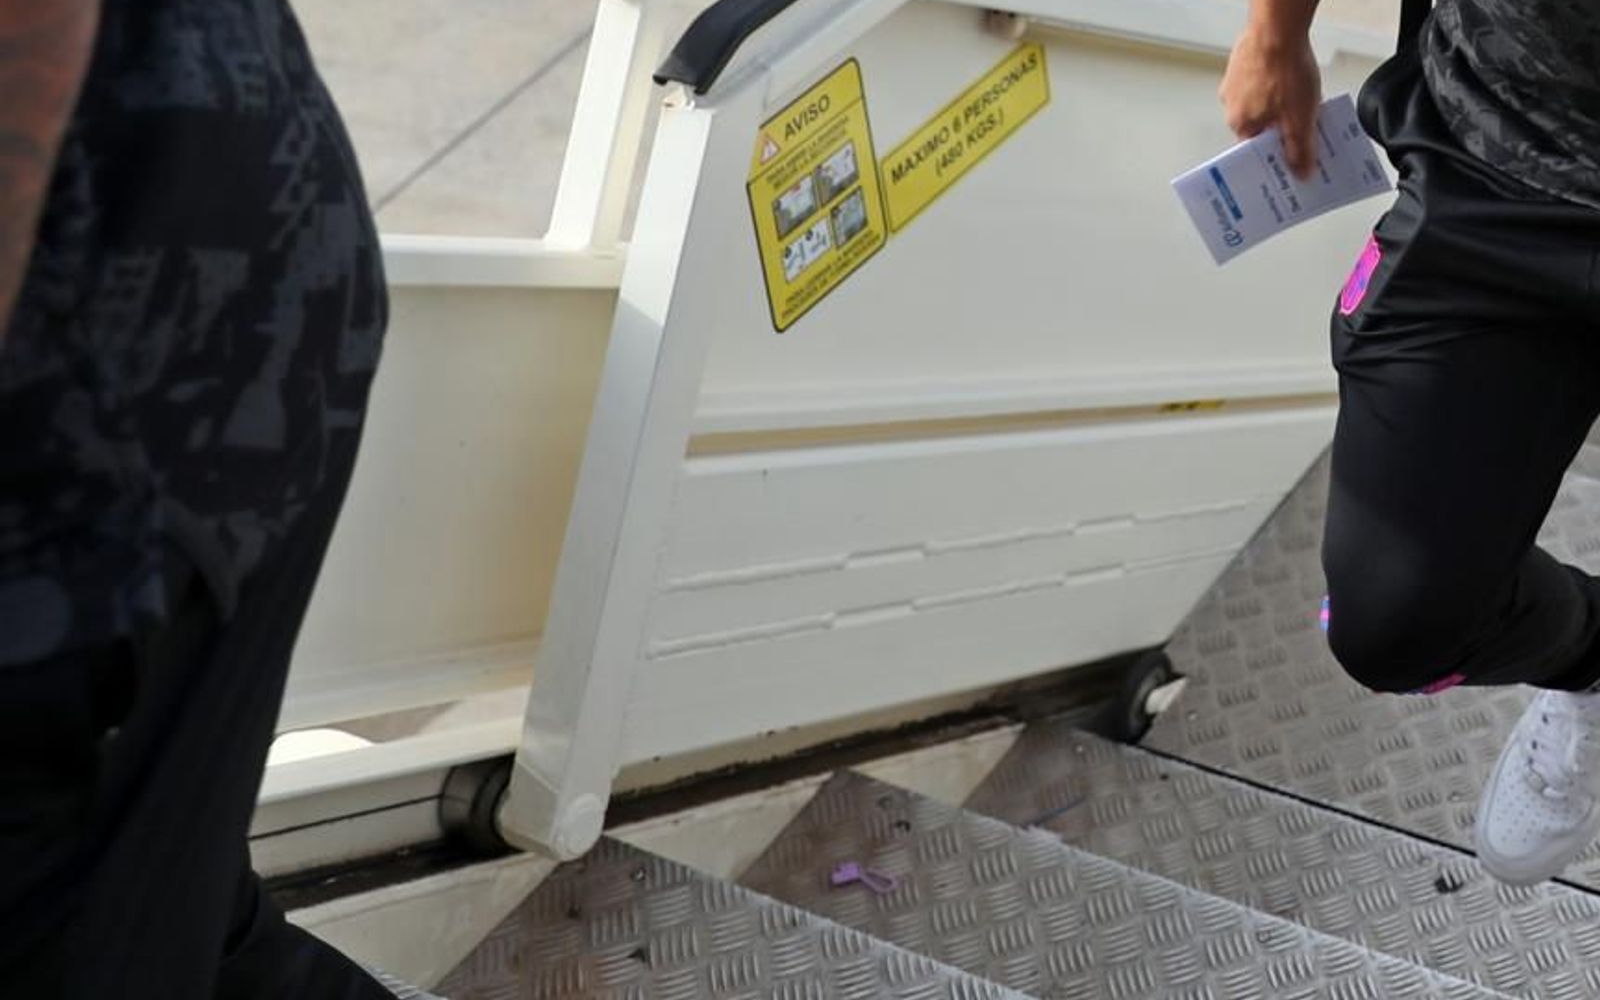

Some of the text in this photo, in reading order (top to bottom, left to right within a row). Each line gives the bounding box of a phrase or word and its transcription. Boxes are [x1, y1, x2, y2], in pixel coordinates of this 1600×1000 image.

[784, 94, 830, 141] AVISO
[891, 126, 950, 185] MAXIMO
[963, 53, 1038, 124] PERSONAS
